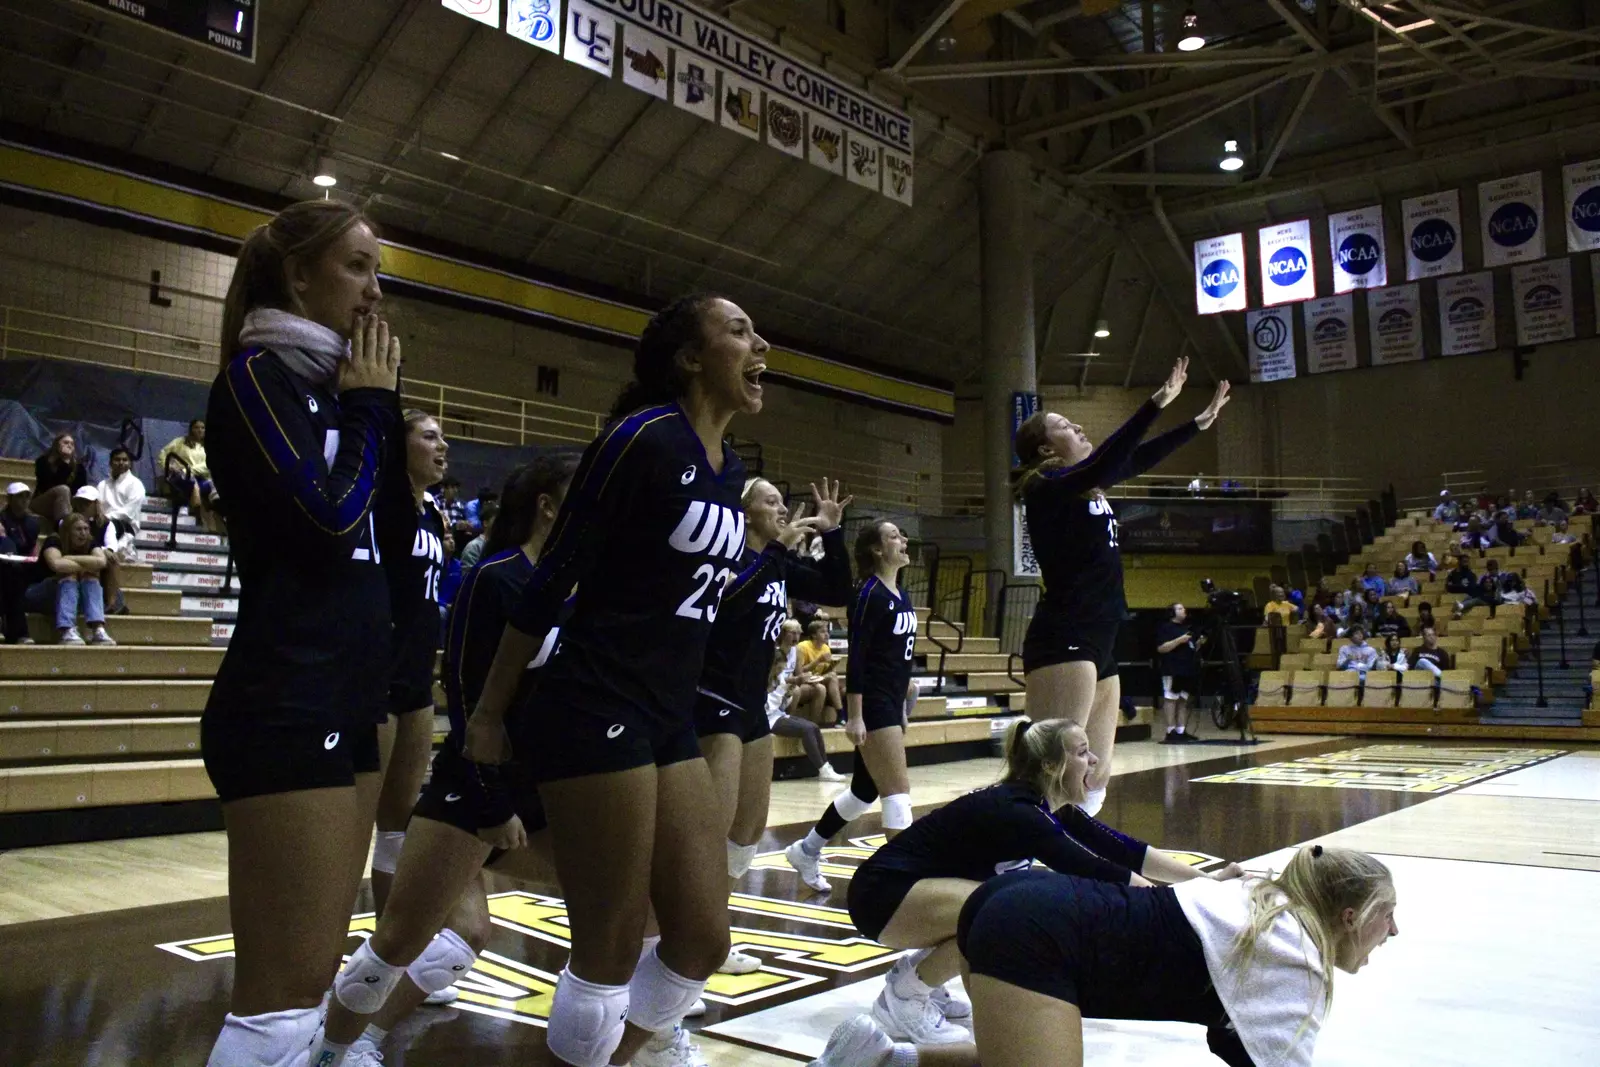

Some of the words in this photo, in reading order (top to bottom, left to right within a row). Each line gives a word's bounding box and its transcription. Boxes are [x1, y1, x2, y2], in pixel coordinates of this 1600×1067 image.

[208, 30, 242, 50] POINTS
[609, 0, 683, 36] OURI
[695, 21, 776, 80] VALLEY
[783, 67, 910, 147] CONFERENCE
[812, 125, 840, 145] UNI
[850, 140, 876, 164] SIU
[1490, 215, 1536, 238] NCAA
[1412, 231, 1455, 251] NCAA
[1339, 246, 1379, 264] NCAA
[1268, 257, 1306, 277] NCAA
[1203, 269, 1239, 288] NCAA
[1088, 496, 1114, 515] UN
[668, 500, 747, 561] UN
[411, 528, 444, 567] UN
[1021, 515, 1031, 573] AMERICA
[146, 552, 168, 561] meijer
[196, 556, 218, 564] meijer
[198, 576, 221, 585] meijer
[675, 563, 730, 623] 23
[757, 580, 787, 608] UN
[200, 600, 224, 609] meijer
[211, 626, 227, 636] eijer
[893, 611, 917, 635] UN
[904, 635, 915, 661] 8
